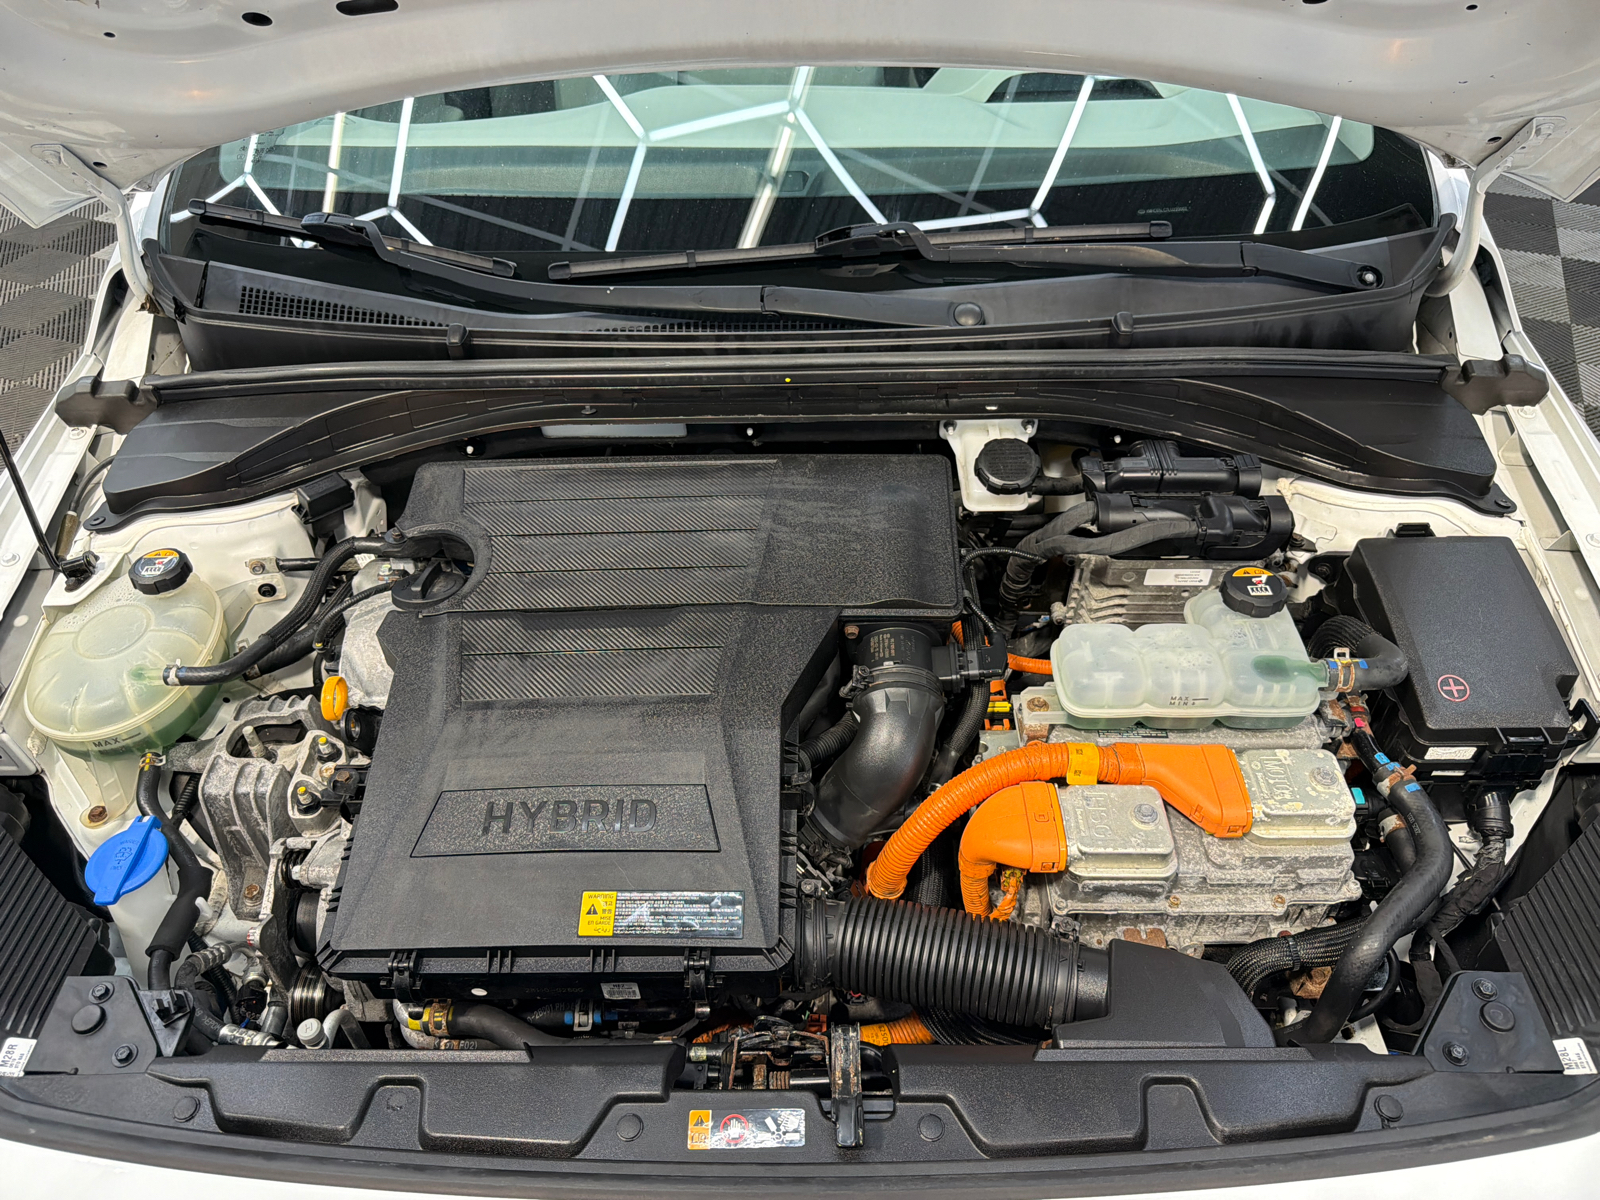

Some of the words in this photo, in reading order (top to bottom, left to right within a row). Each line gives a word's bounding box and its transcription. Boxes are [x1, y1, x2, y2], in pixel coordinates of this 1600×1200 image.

[92, 737, 120, 748] MAX
[481, 799, 657, 835] HYBRID
[0, 1044, 18, 1067] M28R
[1558, 1046, 1575, 1070] M28L
